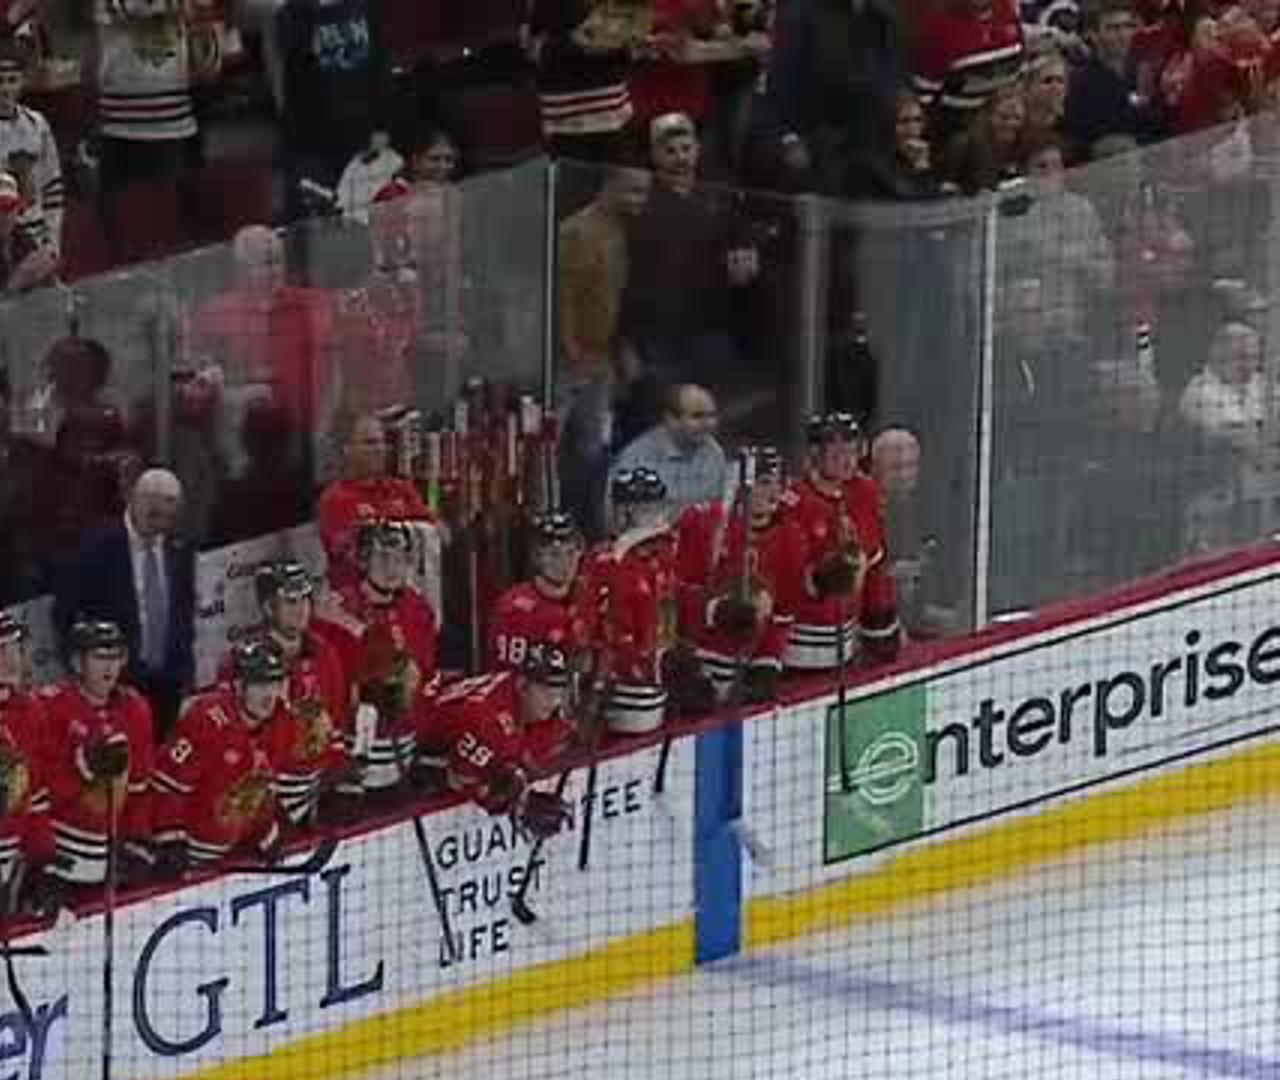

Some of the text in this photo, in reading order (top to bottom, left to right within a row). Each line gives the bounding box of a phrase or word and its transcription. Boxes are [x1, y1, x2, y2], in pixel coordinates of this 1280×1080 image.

[436, 779, 642, 869] GUATEE
[438, 857, 546, 915] TRUST
[132, 862, 385, 1057] GTL
[439, 918, 510, 968] LIFE
